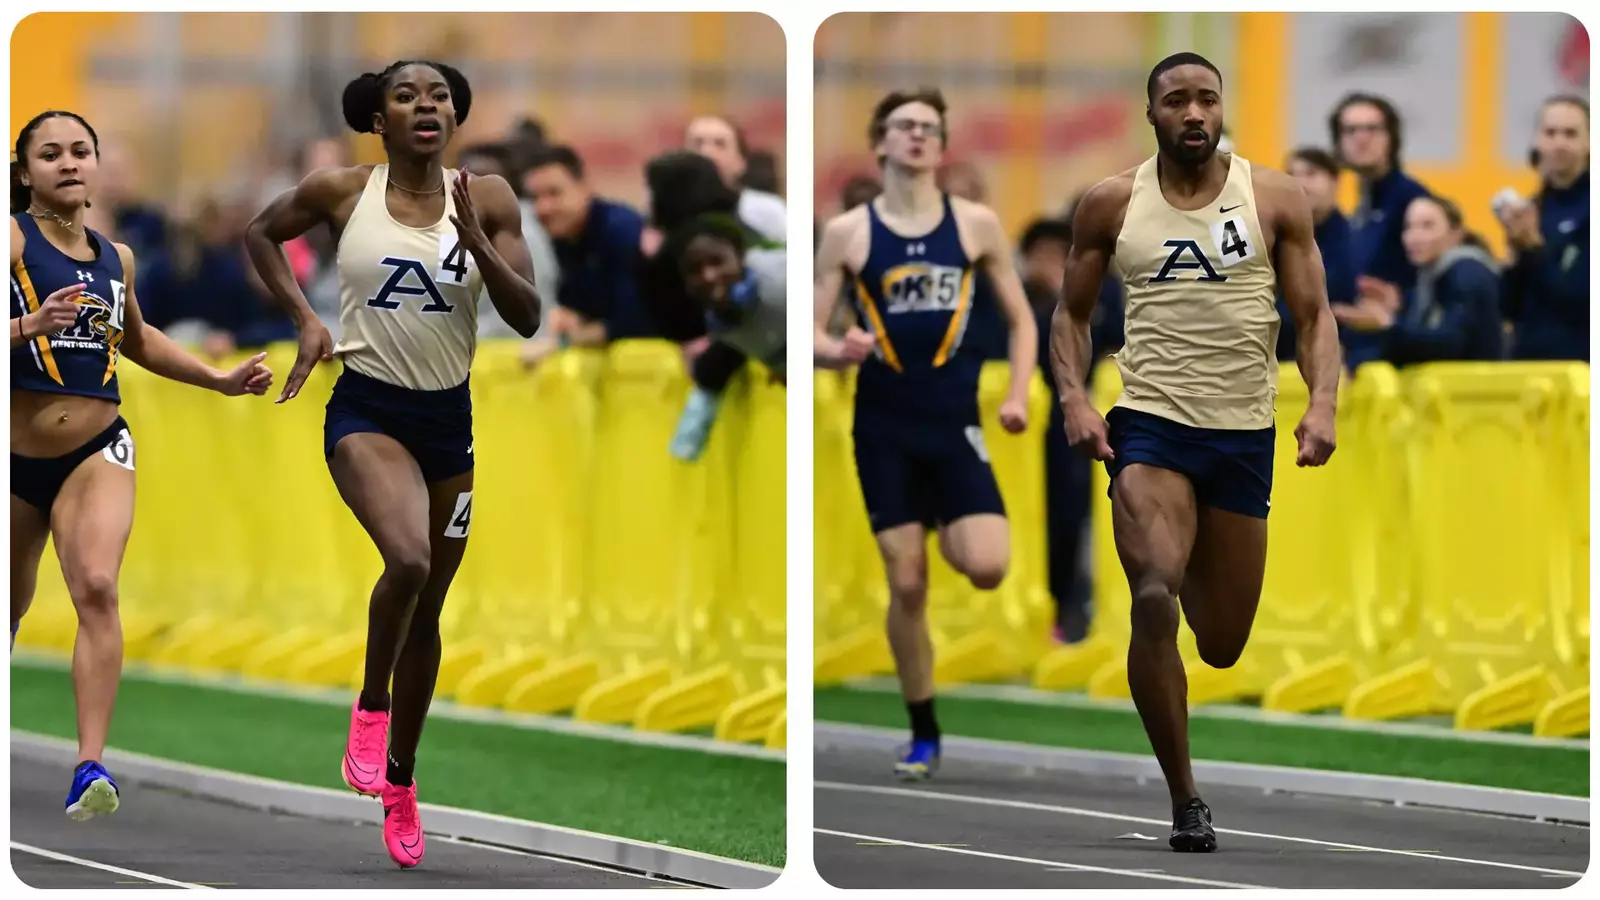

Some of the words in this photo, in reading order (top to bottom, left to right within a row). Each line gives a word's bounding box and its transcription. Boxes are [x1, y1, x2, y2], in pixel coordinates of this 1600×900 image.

[1221, 219, 1248, 259] 4
[441, 239, 468, 283] 4
[1146, 239, 1229, 284] A
[365, 255, 456, 314] A
[938, 272, 955, 305] 5
[51, 340, 75, 348] KENT
[79, 341, 104, 349] STATE
[452, 494, 472, 535] 4
